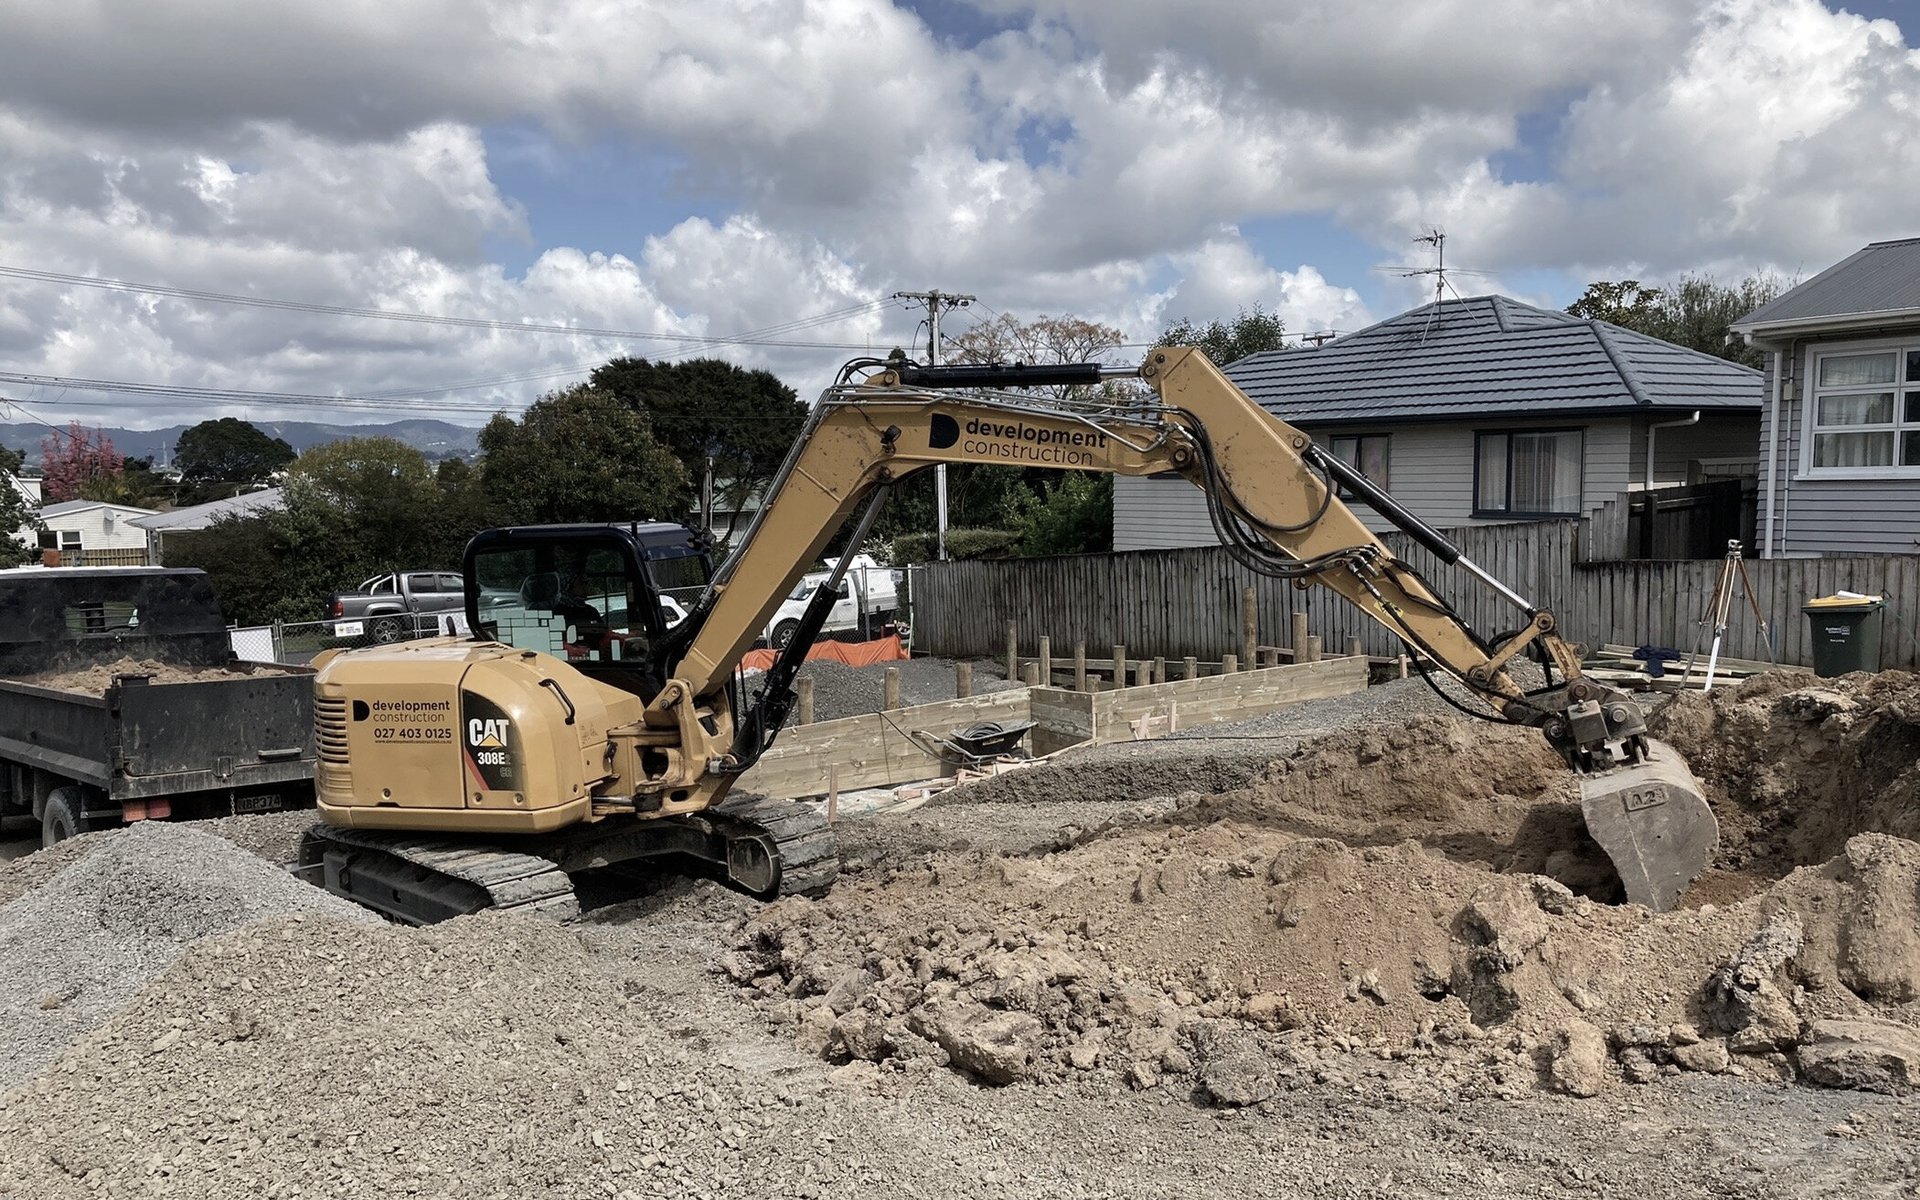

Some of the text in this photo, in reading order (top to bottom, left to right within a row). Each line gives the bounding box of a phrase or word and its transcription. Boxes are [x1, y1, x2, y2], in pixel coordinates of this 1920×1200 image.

[965, 418, 1106, 448] development
[964, 439, 1093, 466] construction
[372, 700, 450, 713] development
[373, 712, 445, 723] construction
[374, 728, 452, 739] 027 403 0125
[469, 718, 510, 747] CAT
